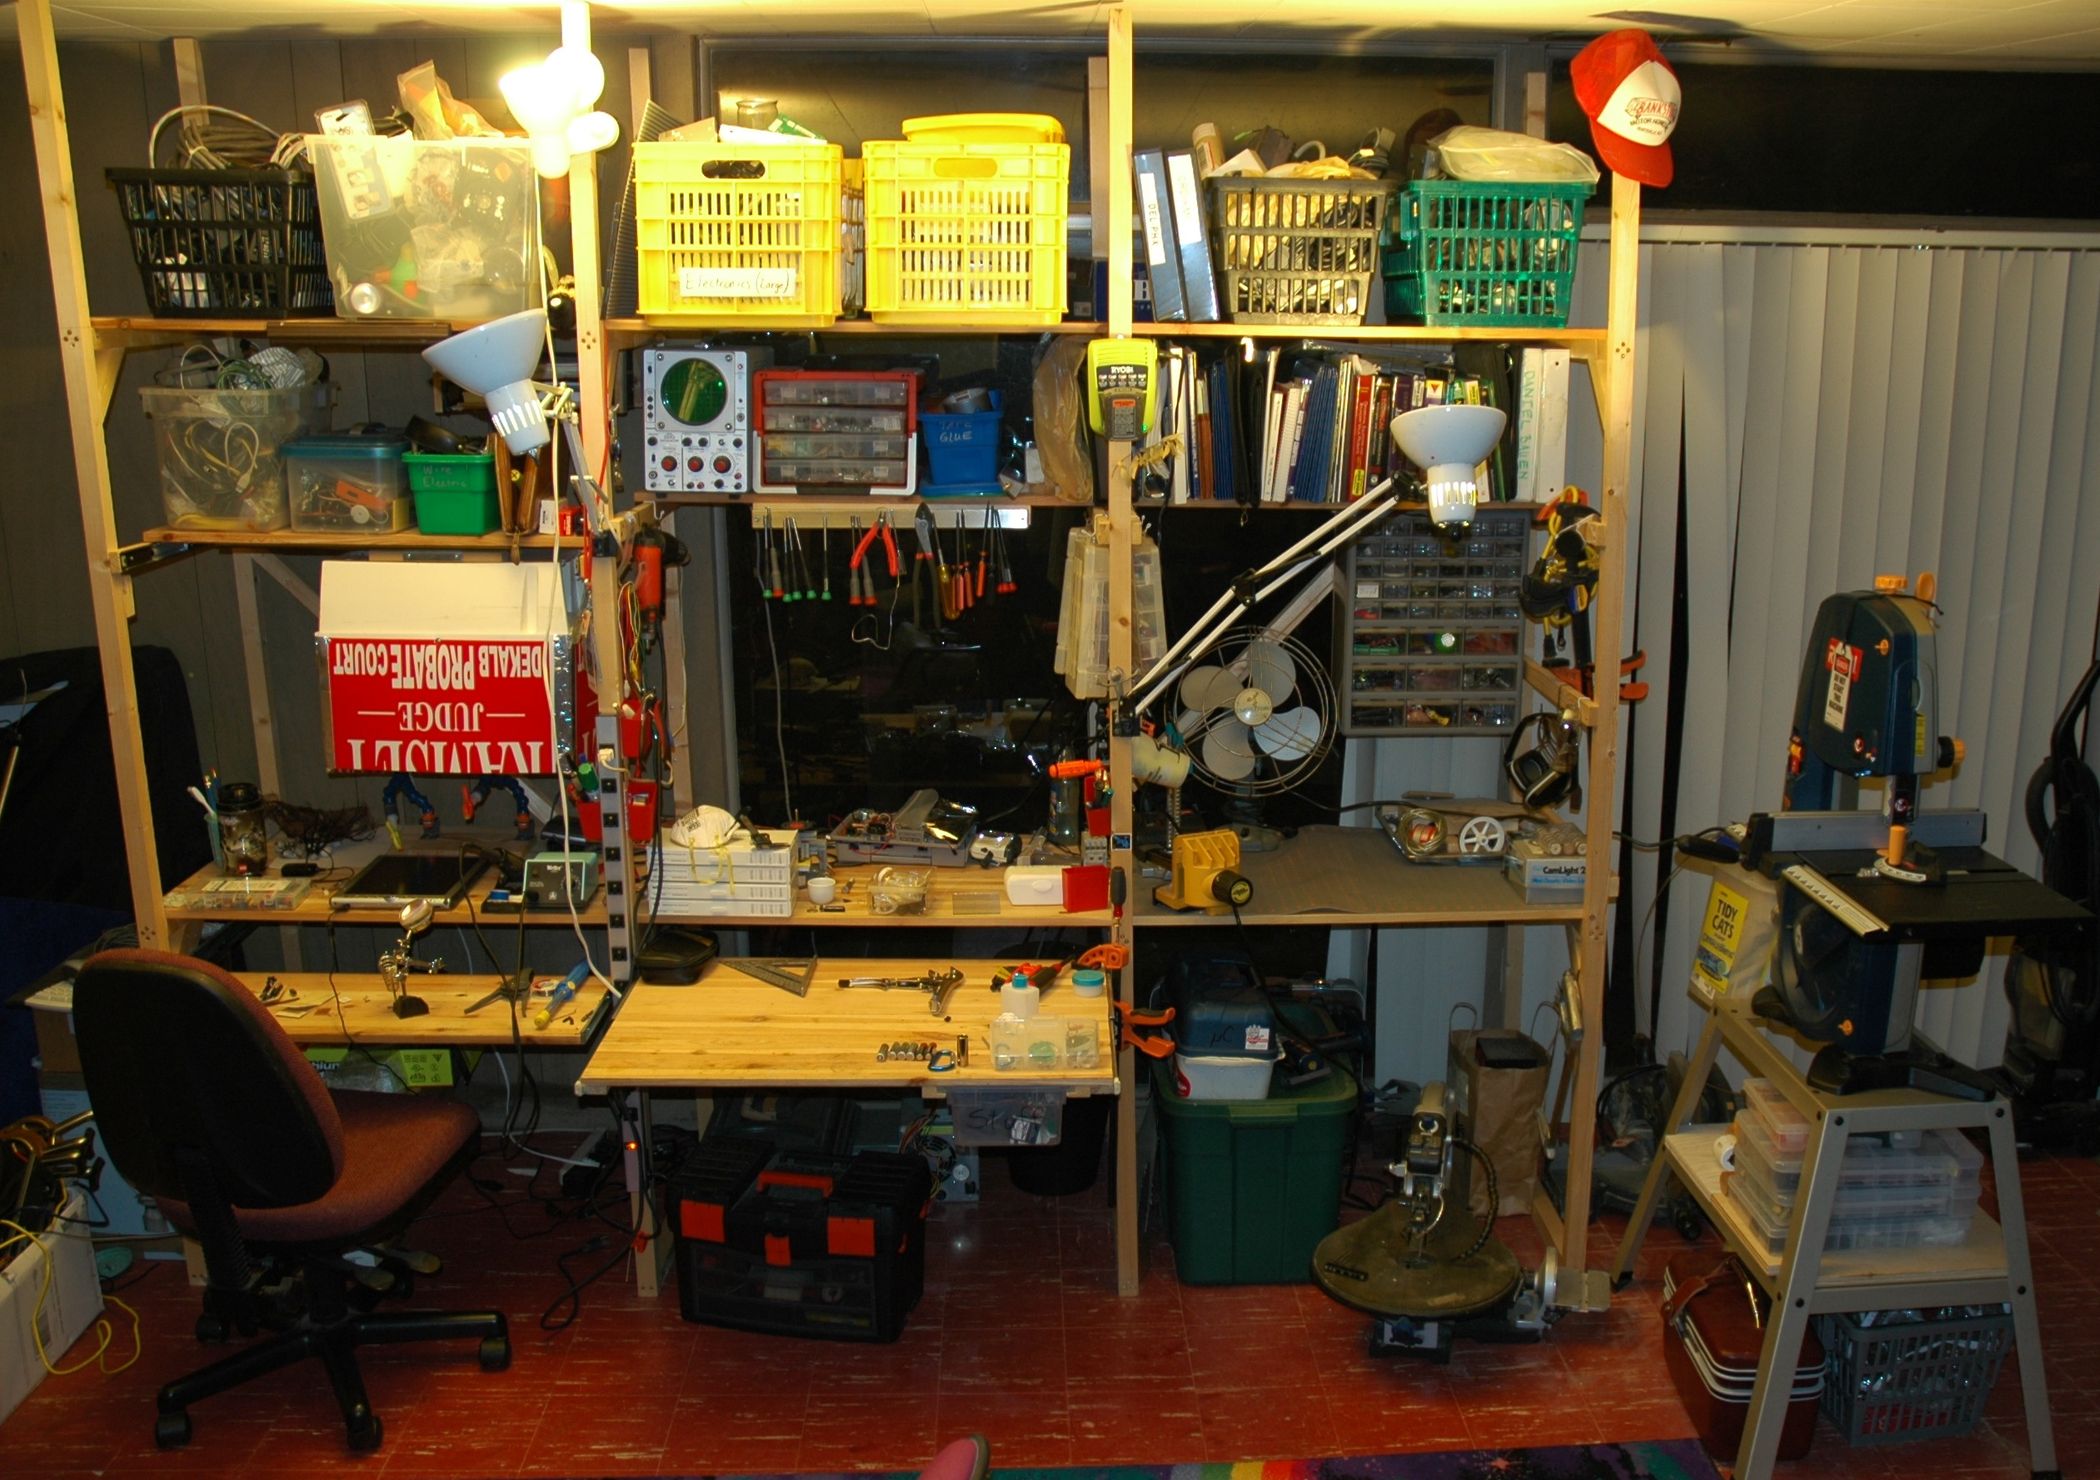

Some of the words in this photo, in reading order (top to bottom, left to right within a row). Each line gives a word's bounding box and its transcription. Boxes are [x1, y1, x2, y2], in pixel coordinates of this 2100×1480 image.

[685, 273, 751, 290] Electronics
[1111, 366, 1134, 374] RYOBI
[940, 430, 973, 442] GLUE
[333, 643, 388, 676] COURT
[389, 644, 475, 690] PROBATE
[479, 645, 542, 678] DEKALB
[397, 702, 484, 732] JUDGE
[1543, 866, 1579, 876] CamLight
[1718, 899, 1738, 922] TIDY
[1712, 915, 1734, 939] CATS
